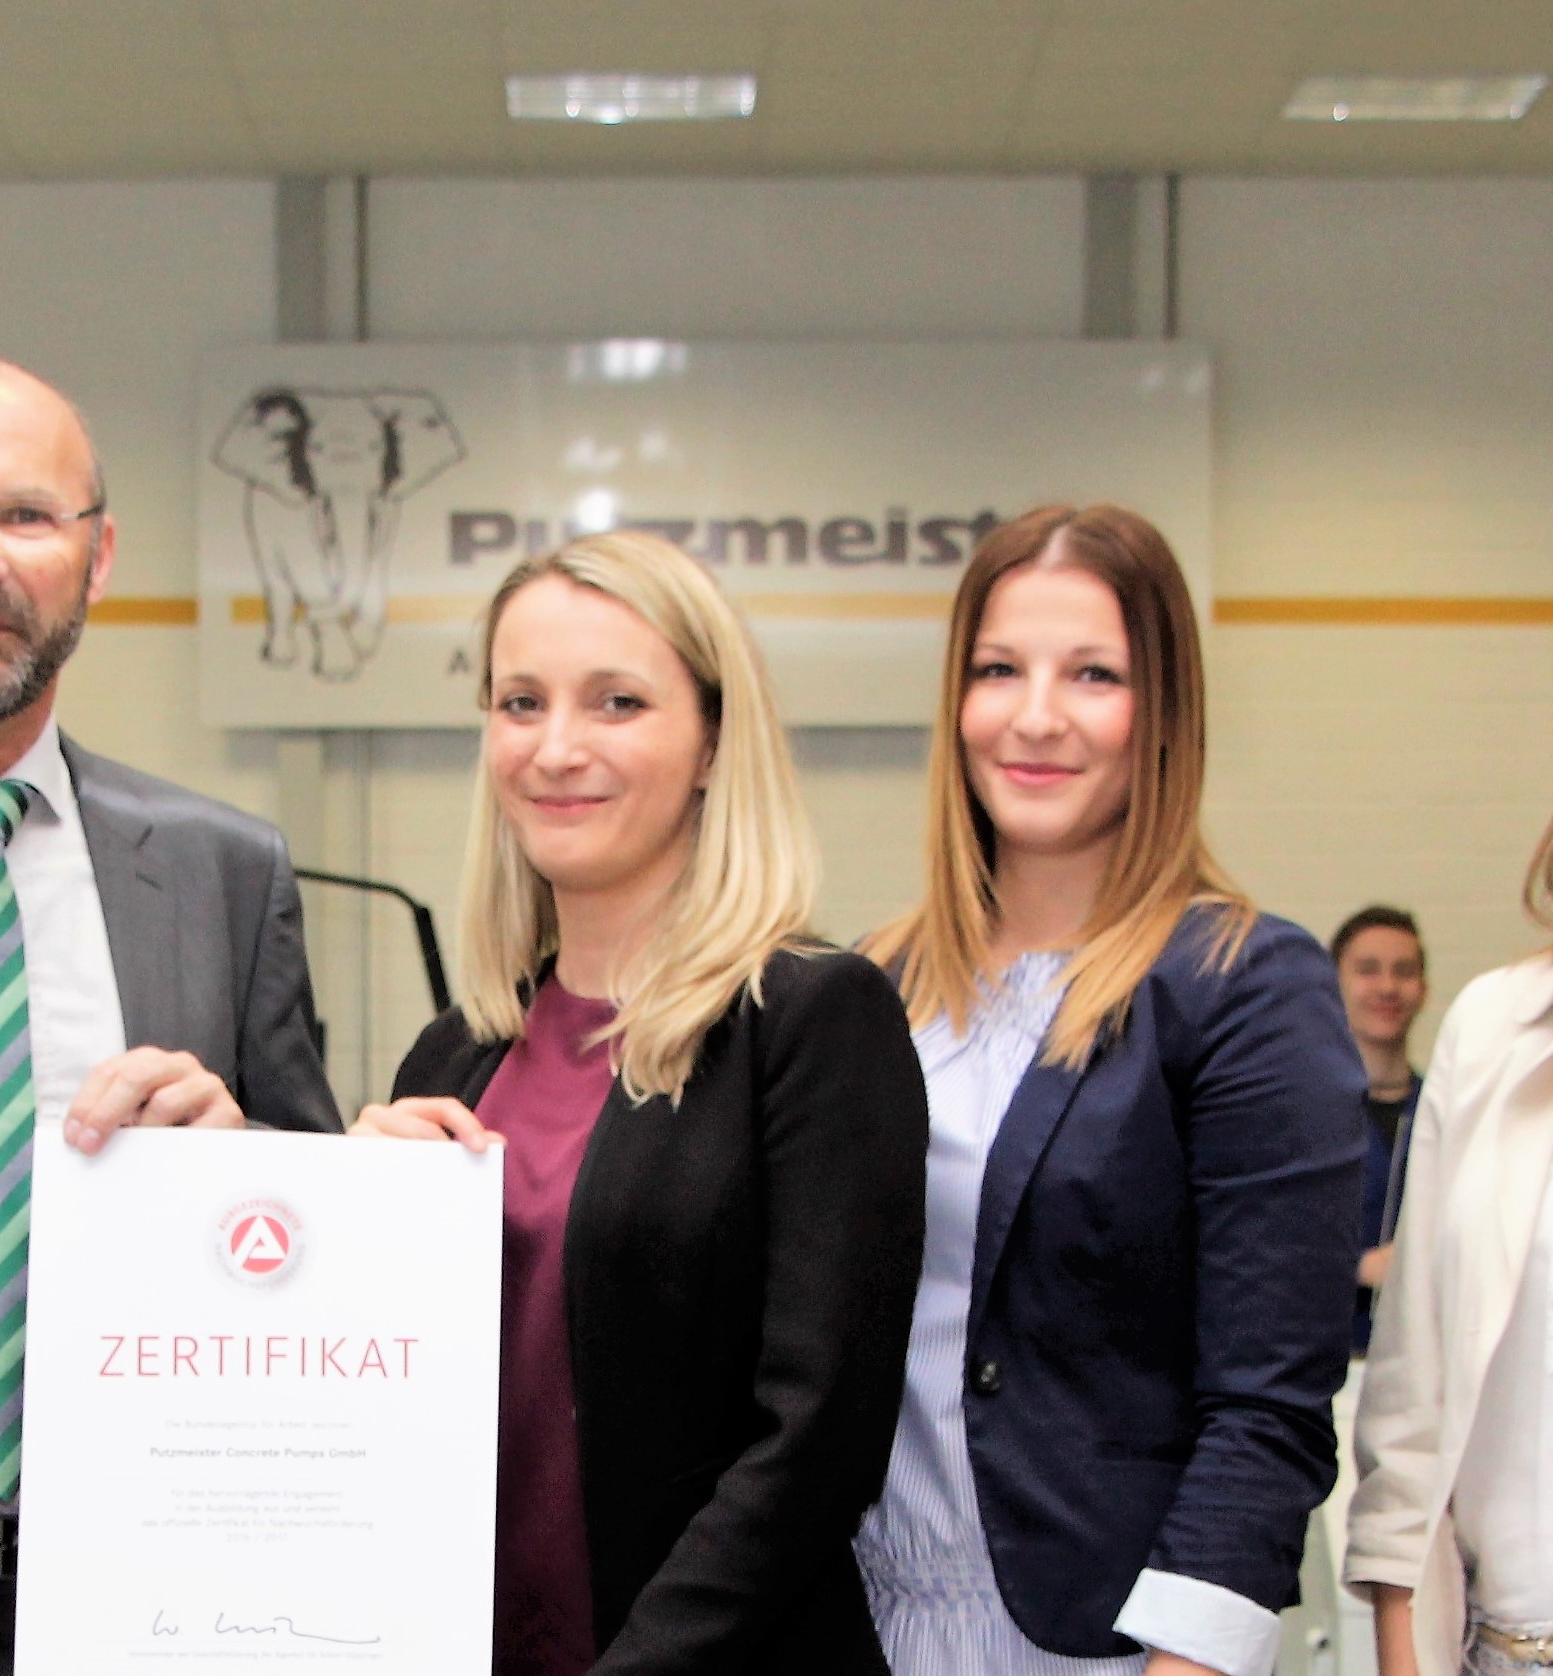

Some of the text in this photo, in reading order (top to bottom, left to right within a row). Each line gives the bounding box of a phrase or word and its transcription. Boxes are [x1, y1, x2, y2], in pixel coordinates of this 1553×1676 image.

[98, 1334, 420, 1379] ZERTIFIKAT
[149, 1446, 367, 1459] Putzmeister Concrete Pumps GmbH
